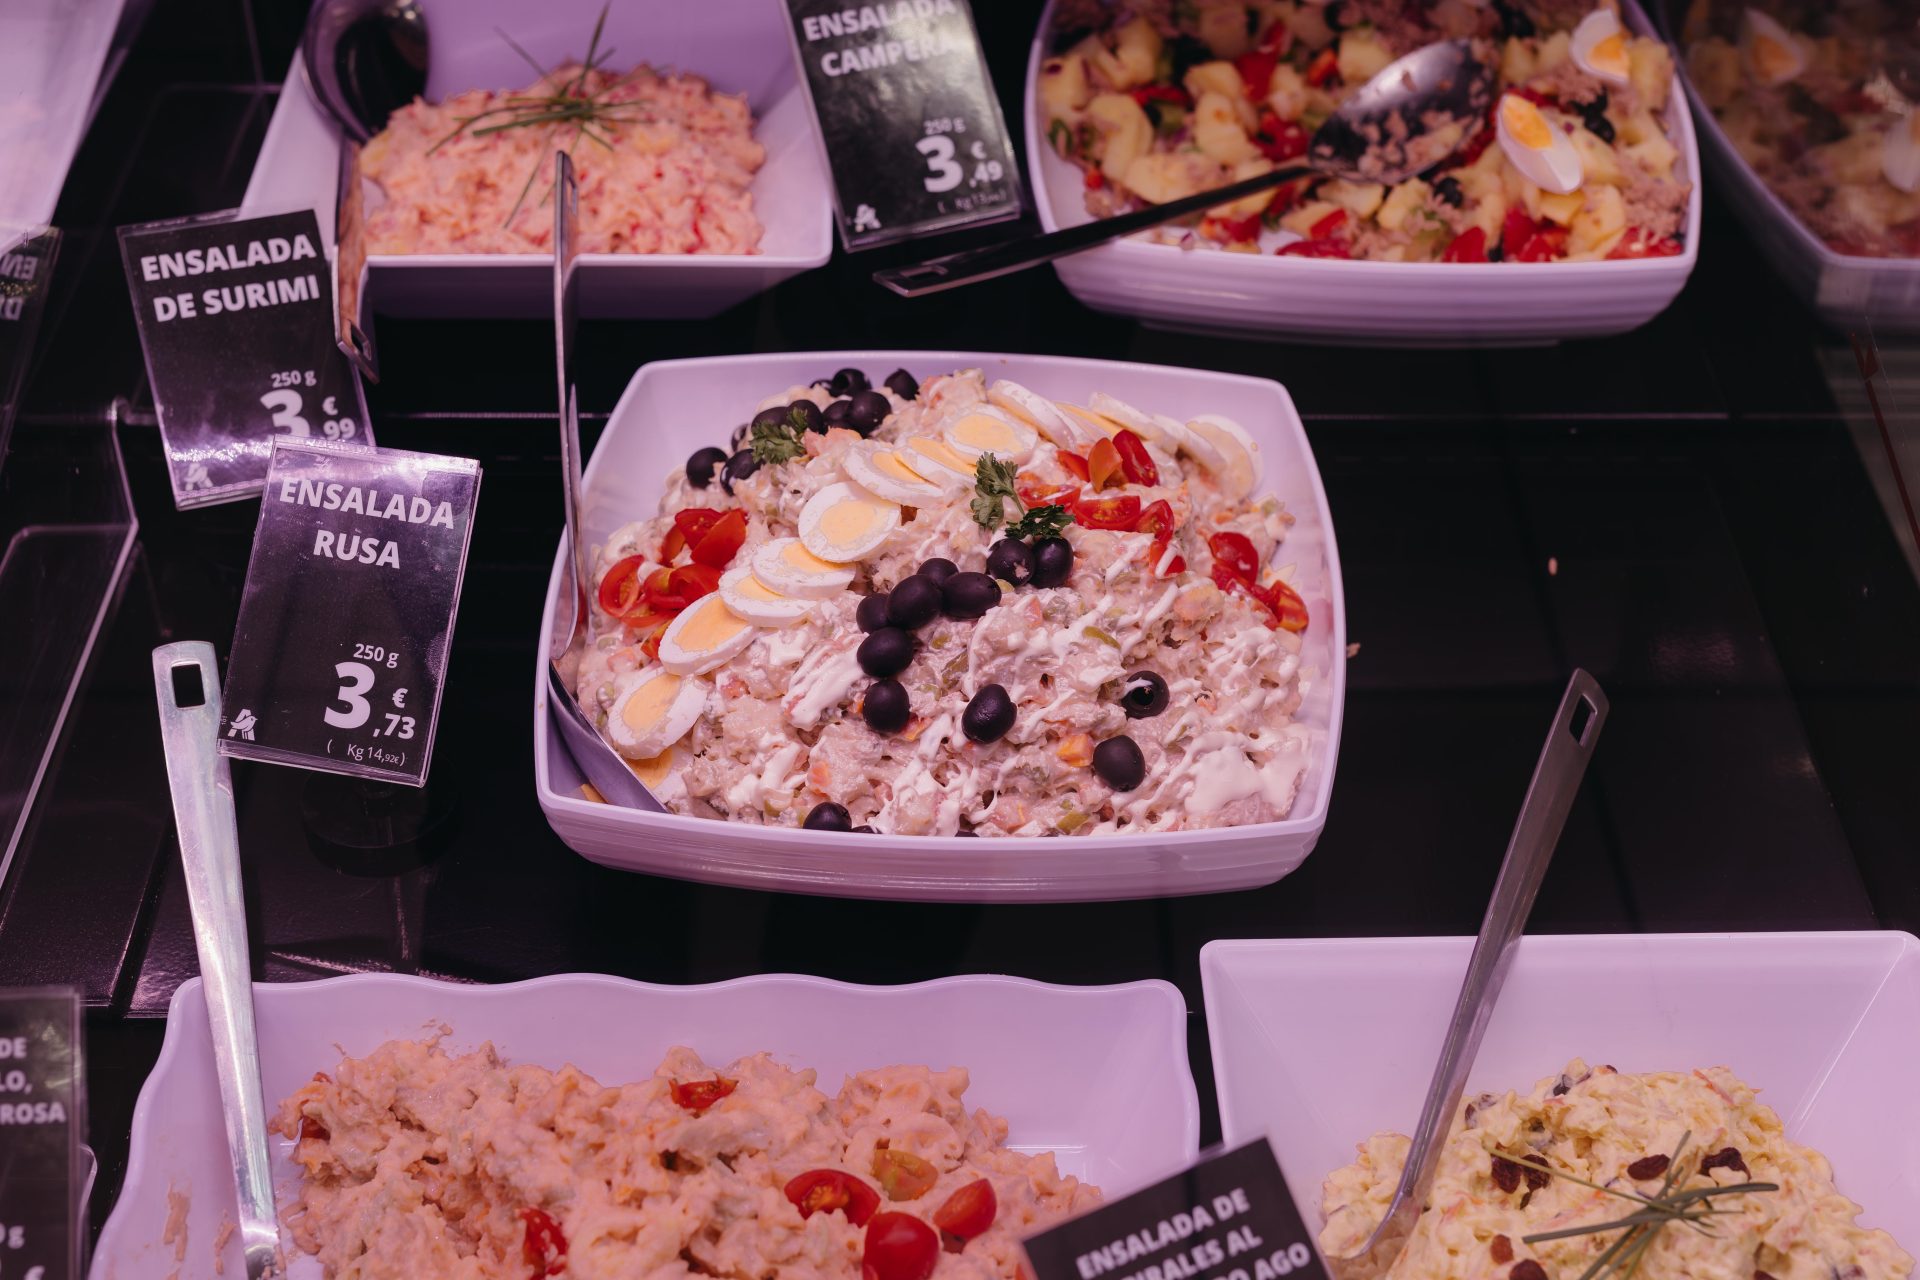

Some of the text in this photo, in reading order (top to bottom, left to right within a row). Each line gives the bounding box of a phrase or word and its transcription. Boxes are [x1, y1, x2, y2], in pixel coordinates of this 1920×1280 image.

[802, 0, 957, 41] ENSALADA
[821, 36, 955, 77] CAMPER
[915, 135, 963, 192] 3
[140, 234, 317, 282] ENSALADA
[153, 274, 320, 323] DE SURIMI
[270, 370, 317, 388] 250 g
[260, 388, 339, 438] 3 €
[279, 476, 454, 529] ENSALADA
[313, 529, 400, 569] RUSA
[353, 643, 399, 669] 250 g
[323, 661, 408, 729] 3 €
[347, 743, 365, 761] Kg
[0, 1037, 27, 1059] DE
[0, 1101, 67, 1125] ROSA
[1075, 1187, 1251, 1280] ENSALADA DE
[1226, 1225, 1263, 1257] AL
[1254, 1242, 1312, 1280] AGO
